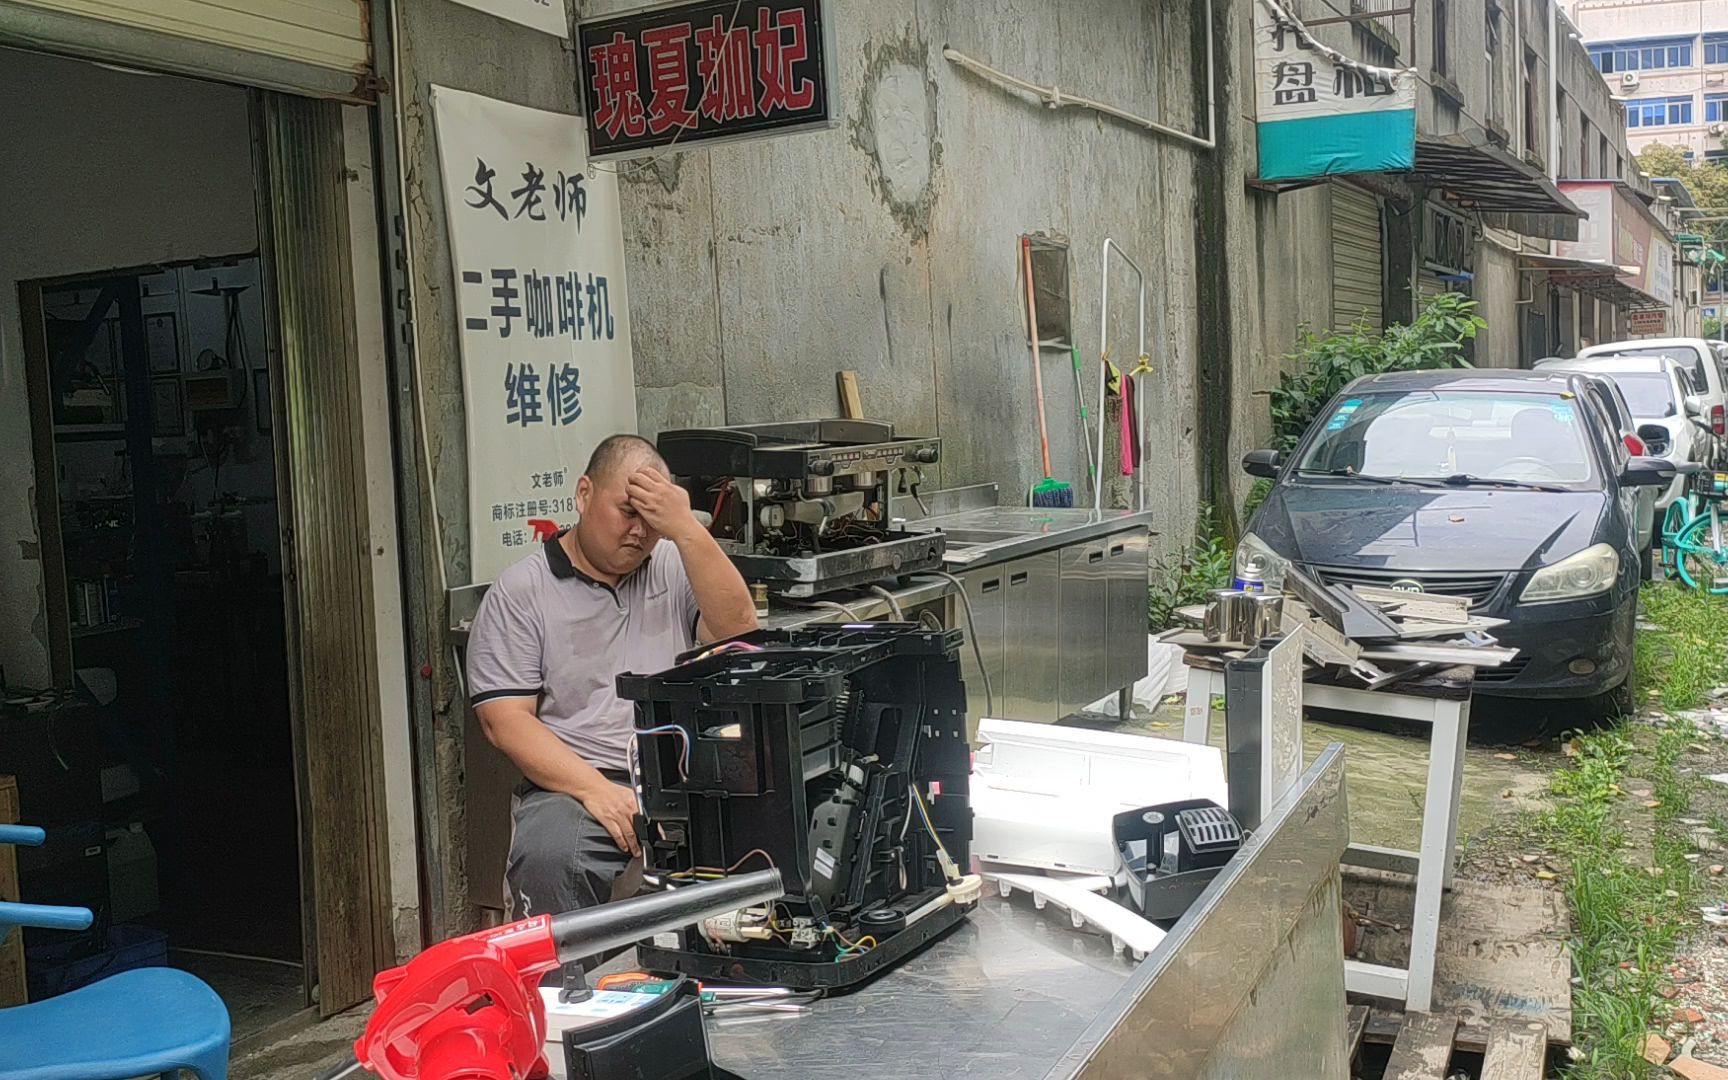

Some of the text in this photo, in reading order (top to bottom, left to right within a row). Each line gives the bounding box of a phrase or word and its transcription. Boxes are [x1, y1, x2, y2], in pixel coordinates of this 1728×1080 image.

[588, 6, 816, 141] 瑰夏珈妃
[464, 157, 588, 234] 文老师
[462, 268, 614, 340] 二手咖啡机
[504, 362, 582, 428] 维修
